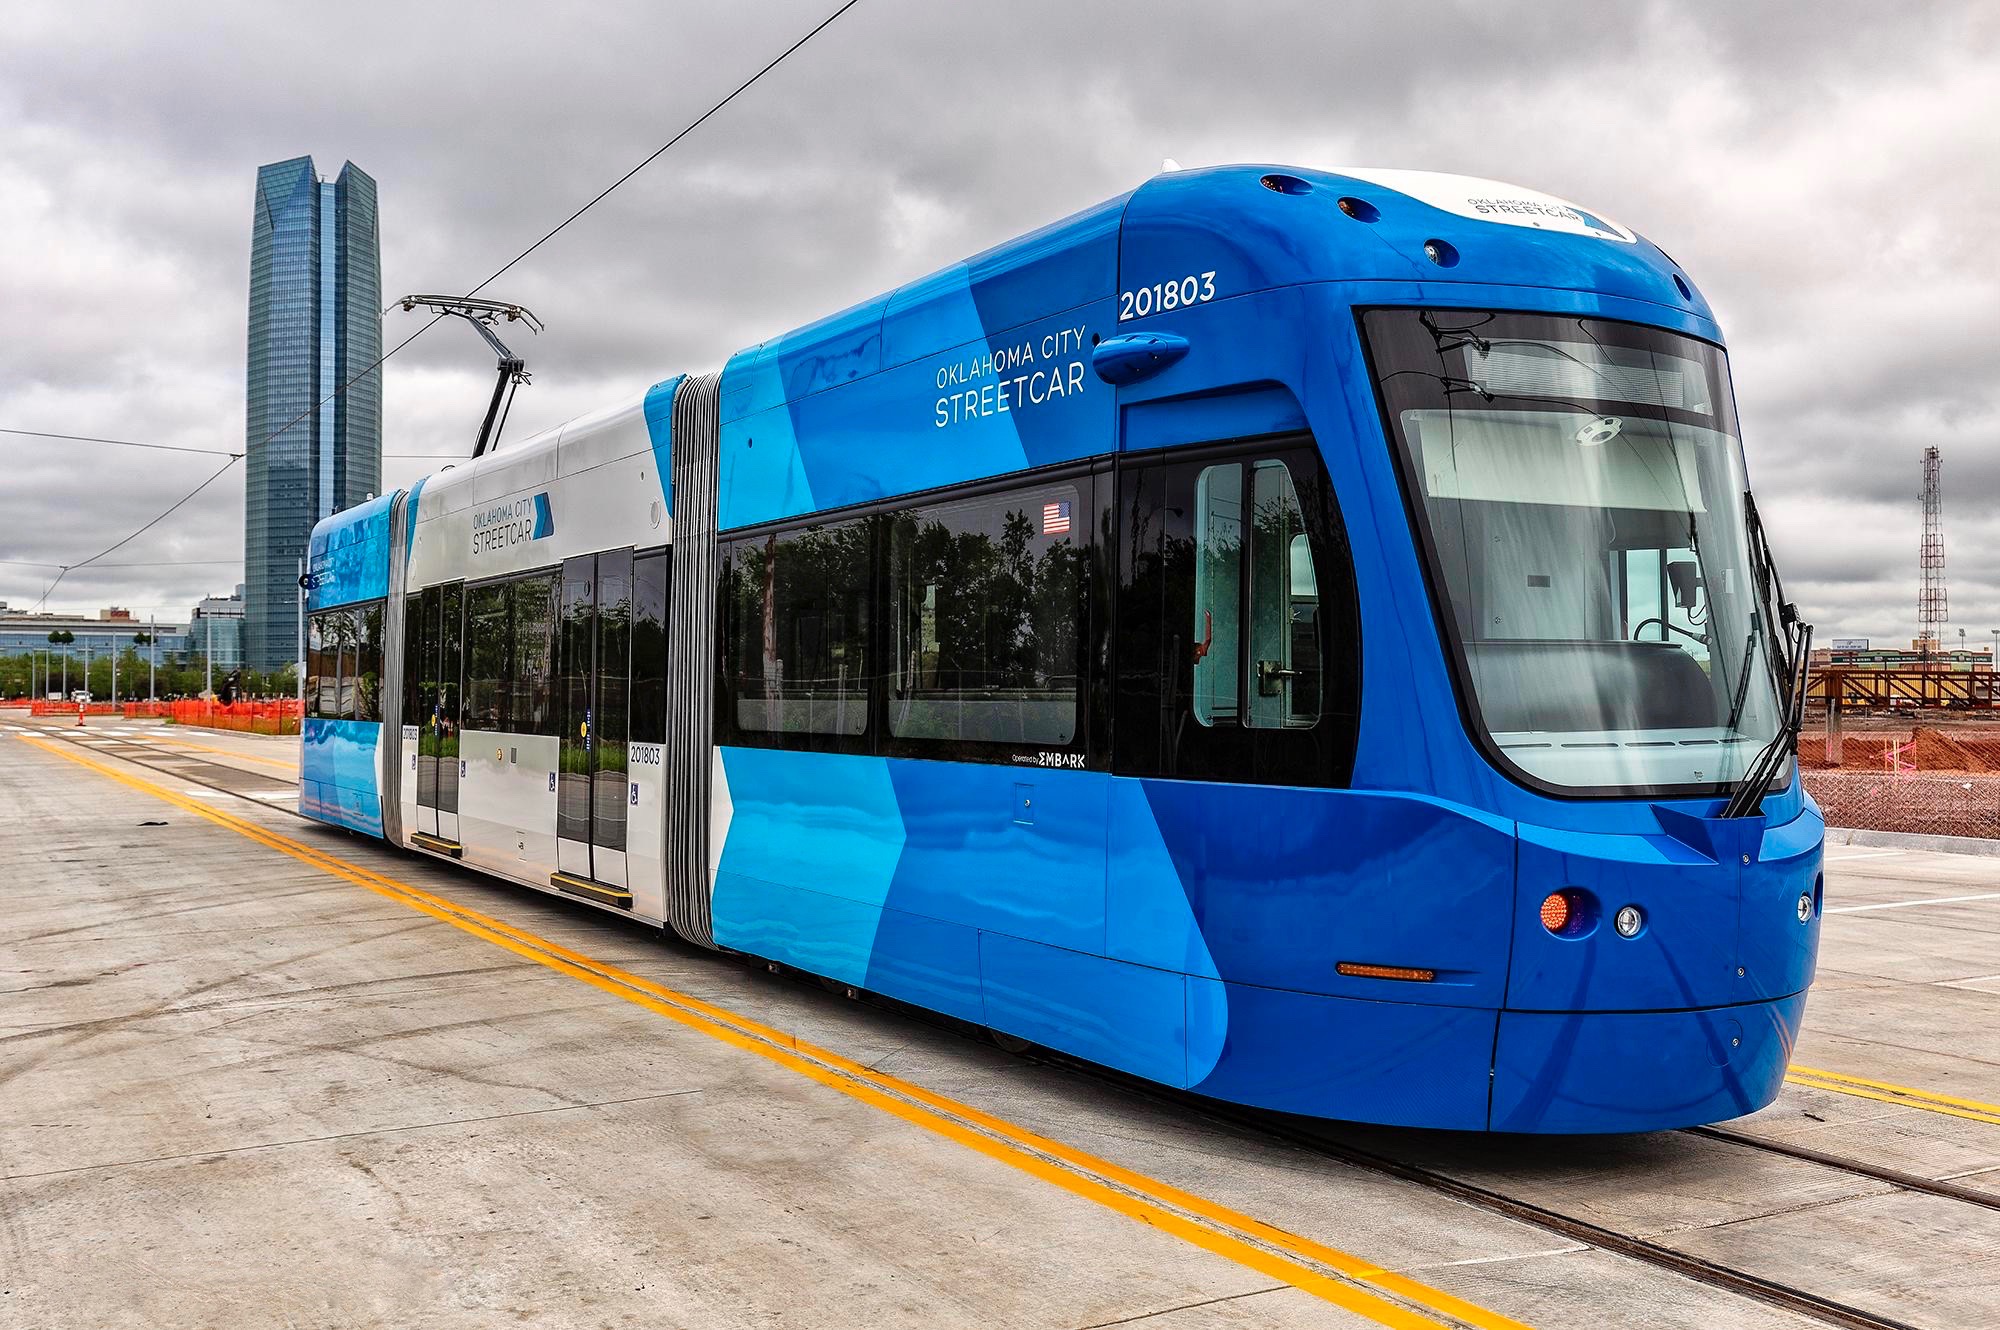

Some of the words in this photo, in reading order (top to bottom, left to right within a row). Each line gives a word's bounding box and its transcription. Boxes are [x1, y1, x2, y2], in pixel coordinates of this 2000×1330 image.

[1475, 204, 1582, 223] STREETCAR
[1119, 271, 1217, 322] 201803
[936, 341, 1034, 389] OKLAHOMA
[1041, 325, 1087, 358] CITY
[935, 361, 1085, 428] STREETCAR
[473, 503, 513, 530] OKLAHOMA
[514, 497, 533, 518] CITY
[473, 519, 532, 554] STREETCAR
[630, 746, 660, 765] 201803
[1012, 754, 1033, 763] Operated
